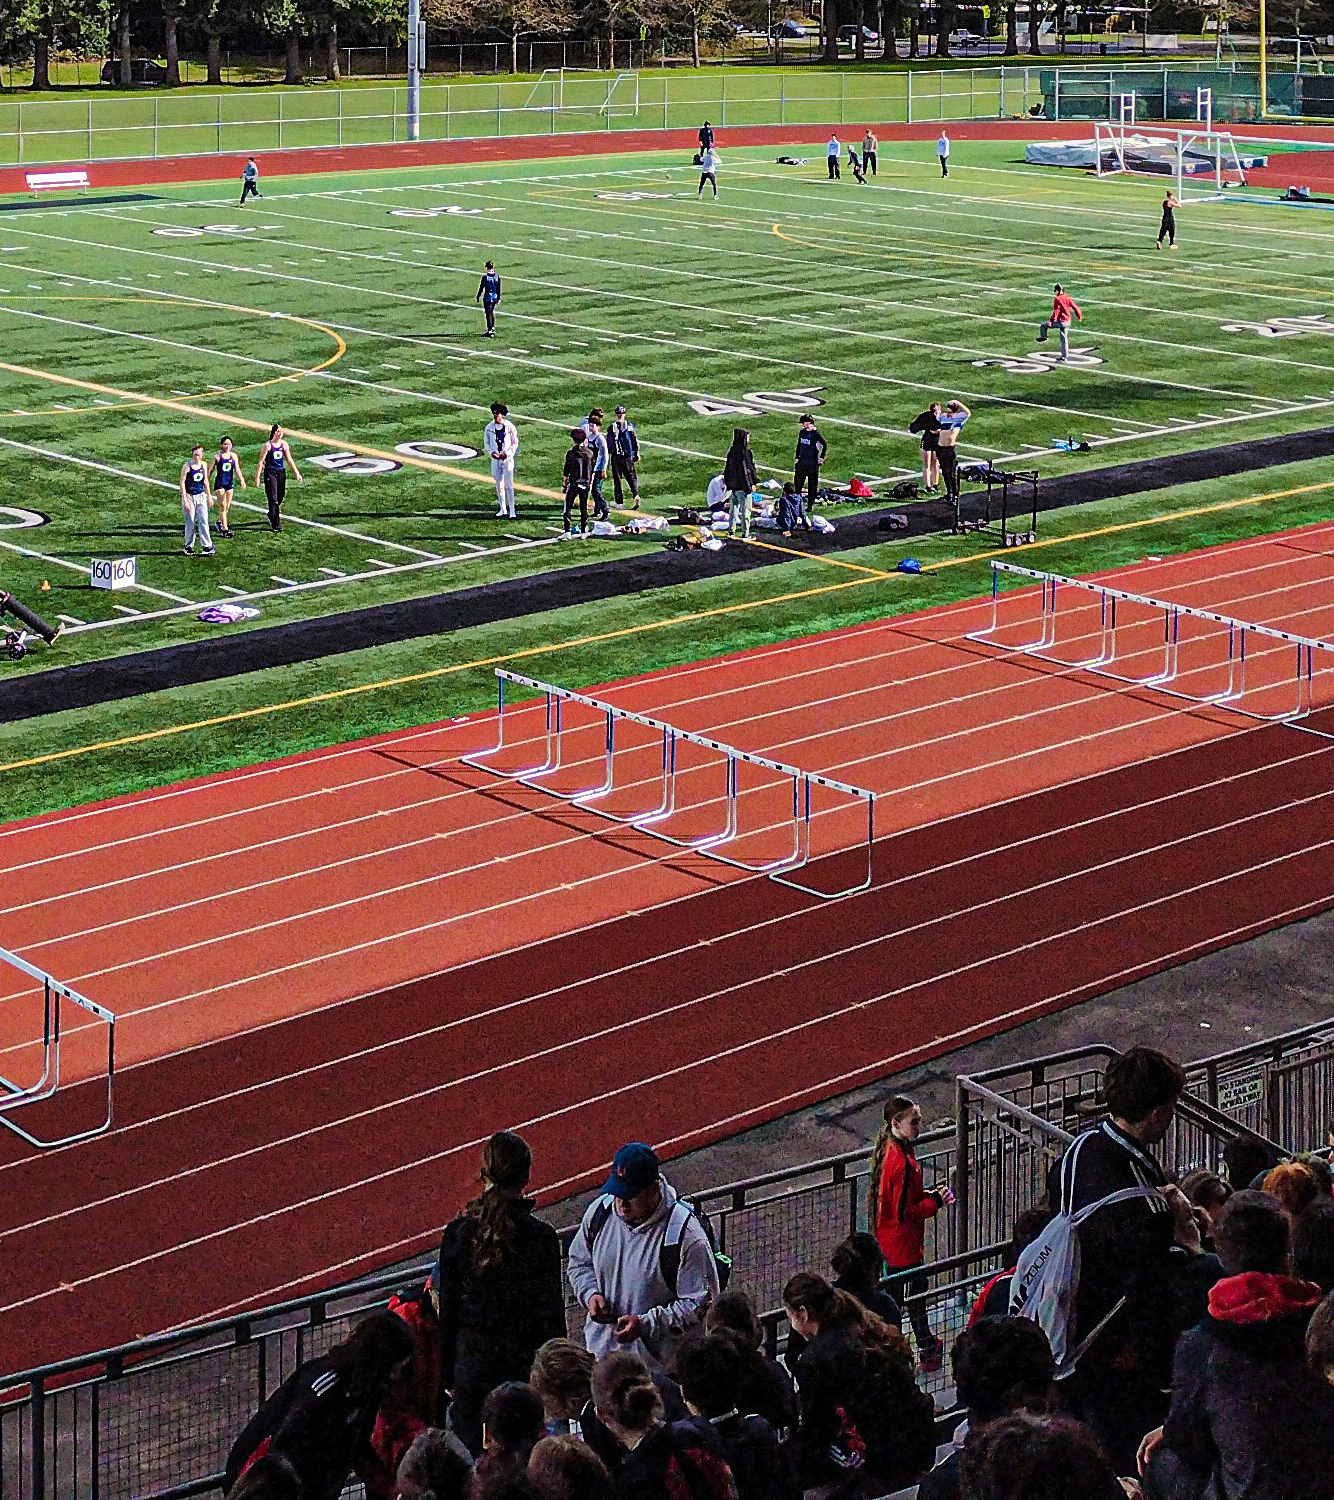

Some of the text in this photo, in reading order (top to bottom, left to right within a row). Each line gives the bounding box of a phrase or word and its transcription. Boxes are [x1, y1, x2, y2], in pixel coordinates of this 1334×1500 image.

[970, 349, 1108, 374] 30
[687, 390, 827, 417] 40
[304, 440, 484, 475] 50
[91, 560, 112, 580] 160
[112, 559, 135, 581] 160
[1219, 1072, 1263, 1092] NO STANDING
[1224, 1091, 1232, 1099] AT
[1248, 1082, 1258, 1092] OR
[1023, 1243, 1053, 1287] ZOOM
